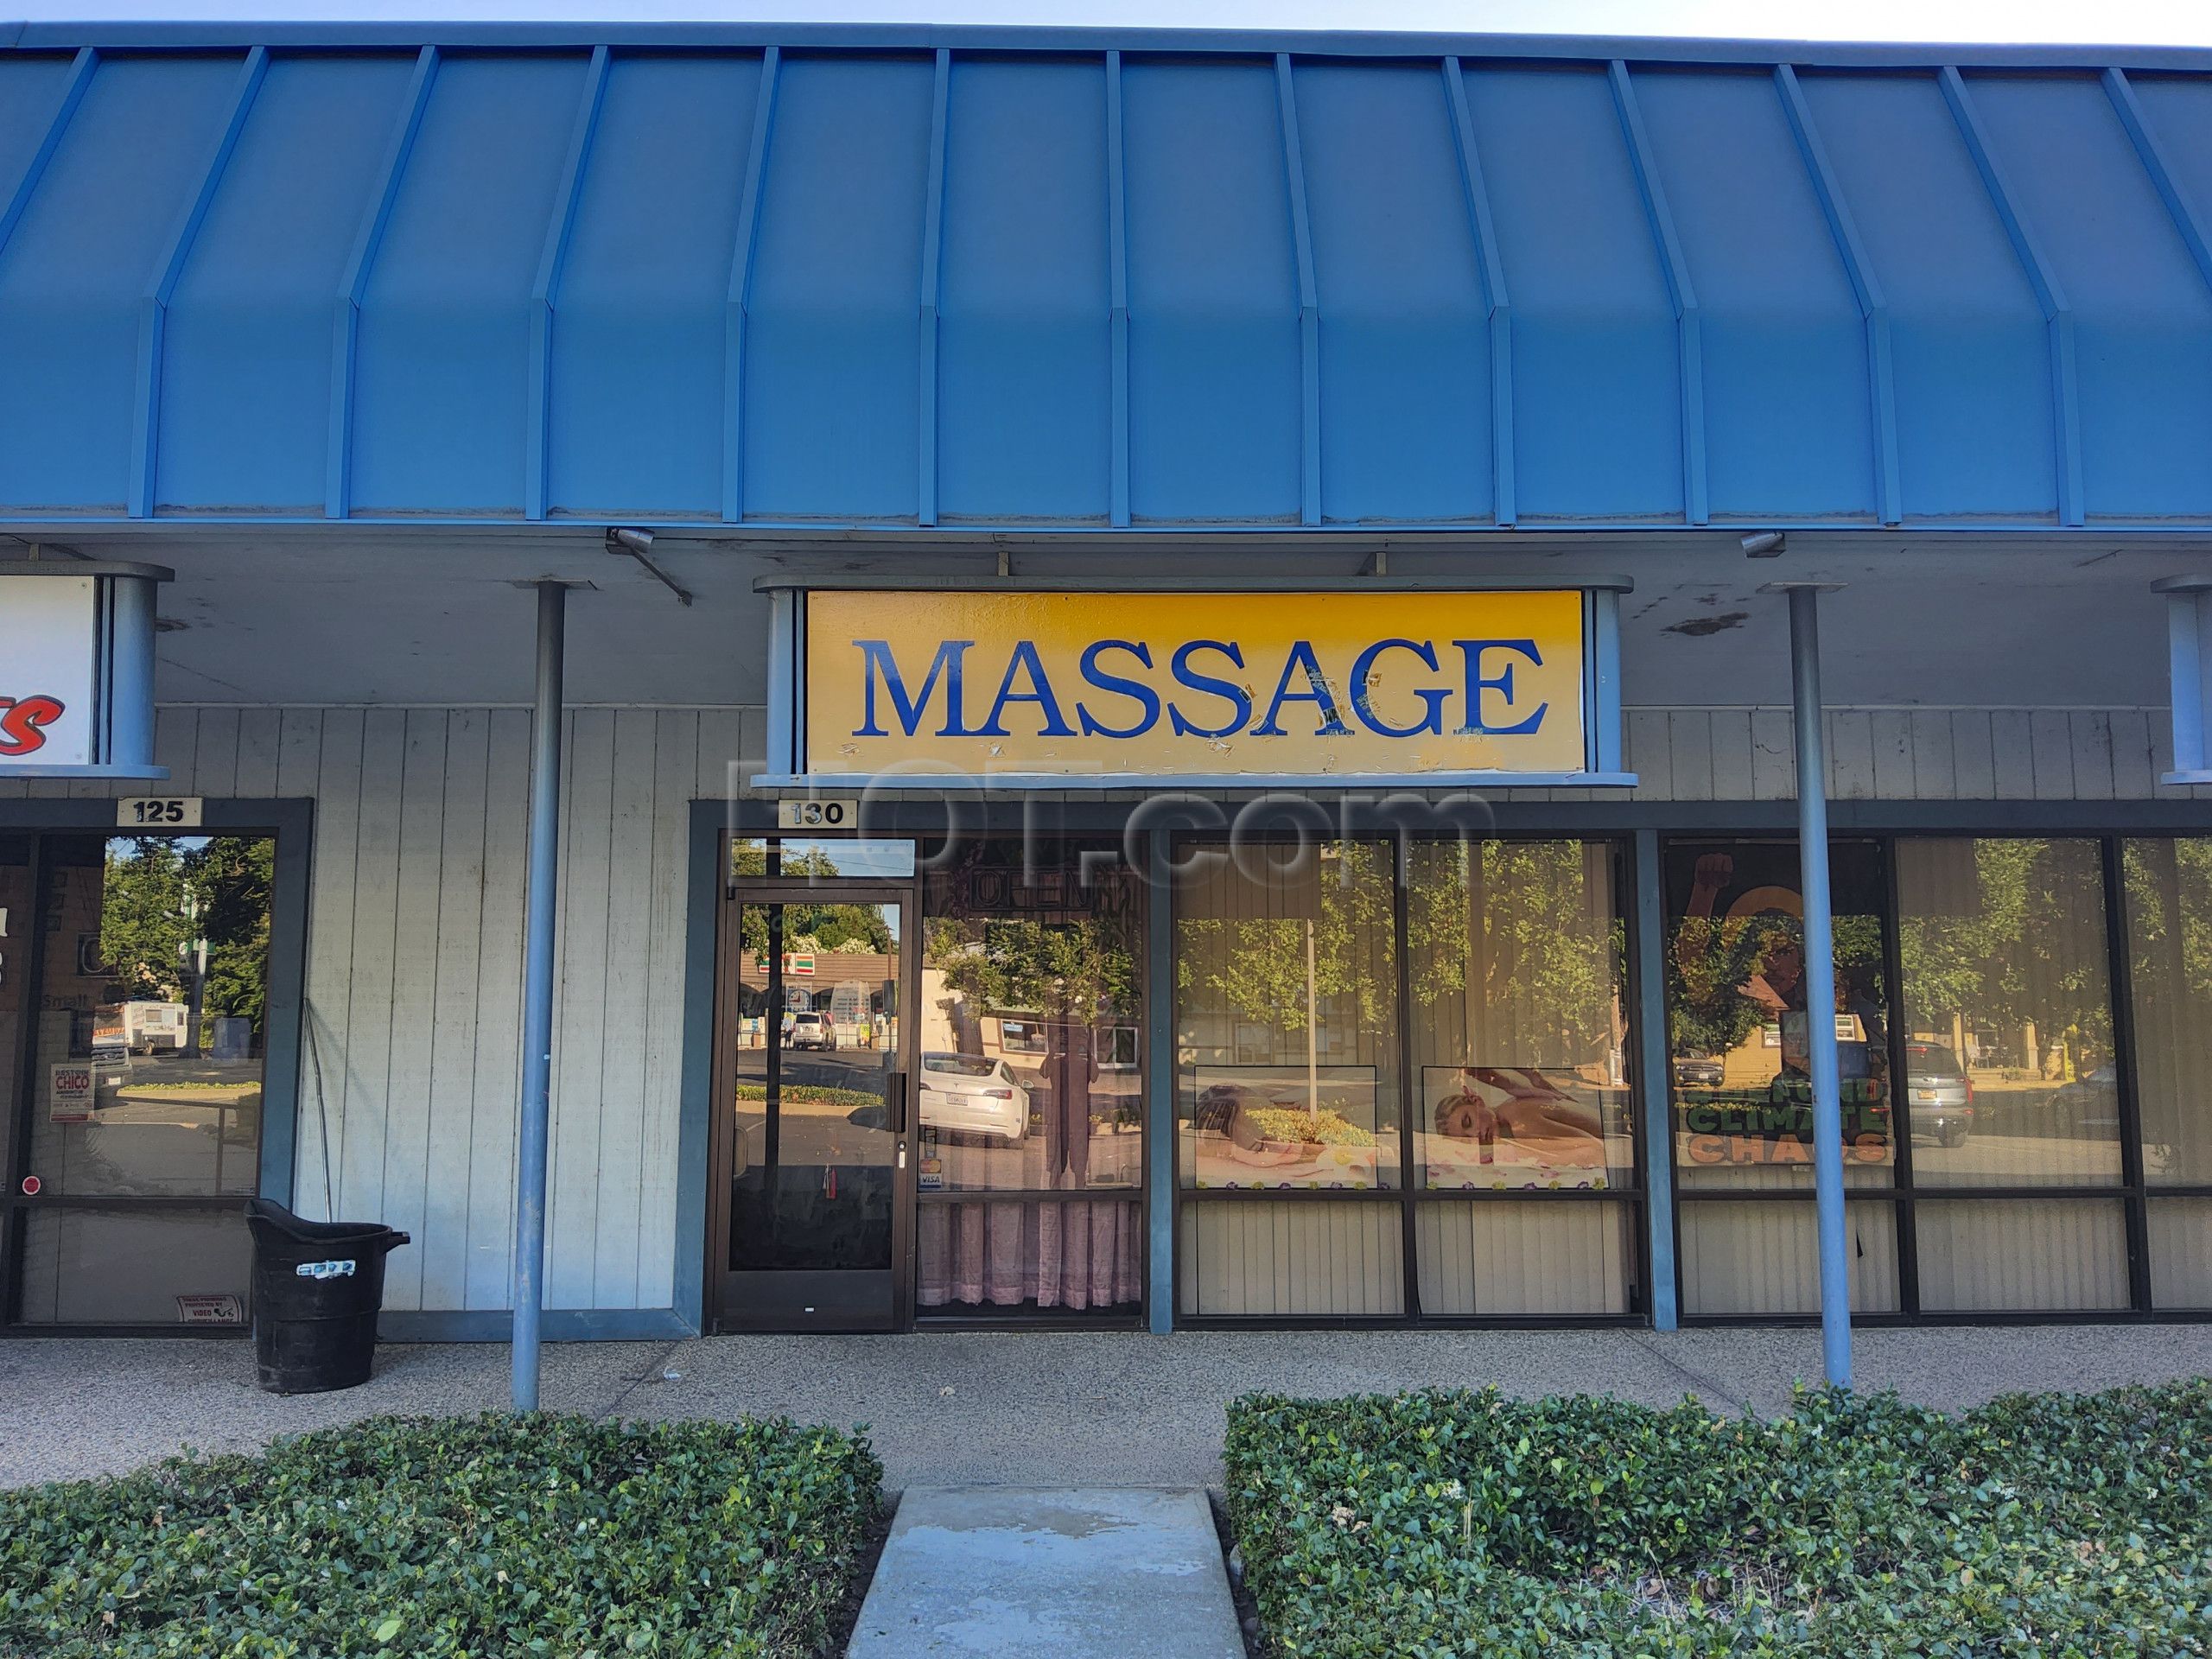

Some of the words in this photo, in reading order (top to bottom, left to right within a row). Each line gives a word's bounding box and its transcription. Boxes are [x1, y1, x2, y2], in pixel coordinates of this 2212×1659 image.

[850, 638, 1549, 739] MASSAGE
[132, 801, 183, 823] 125
[791, 802, 844, 825] 130
[55, 1076, 90, 1090] CHICO
[1688, 1133, 1888, 1163] CHAS
